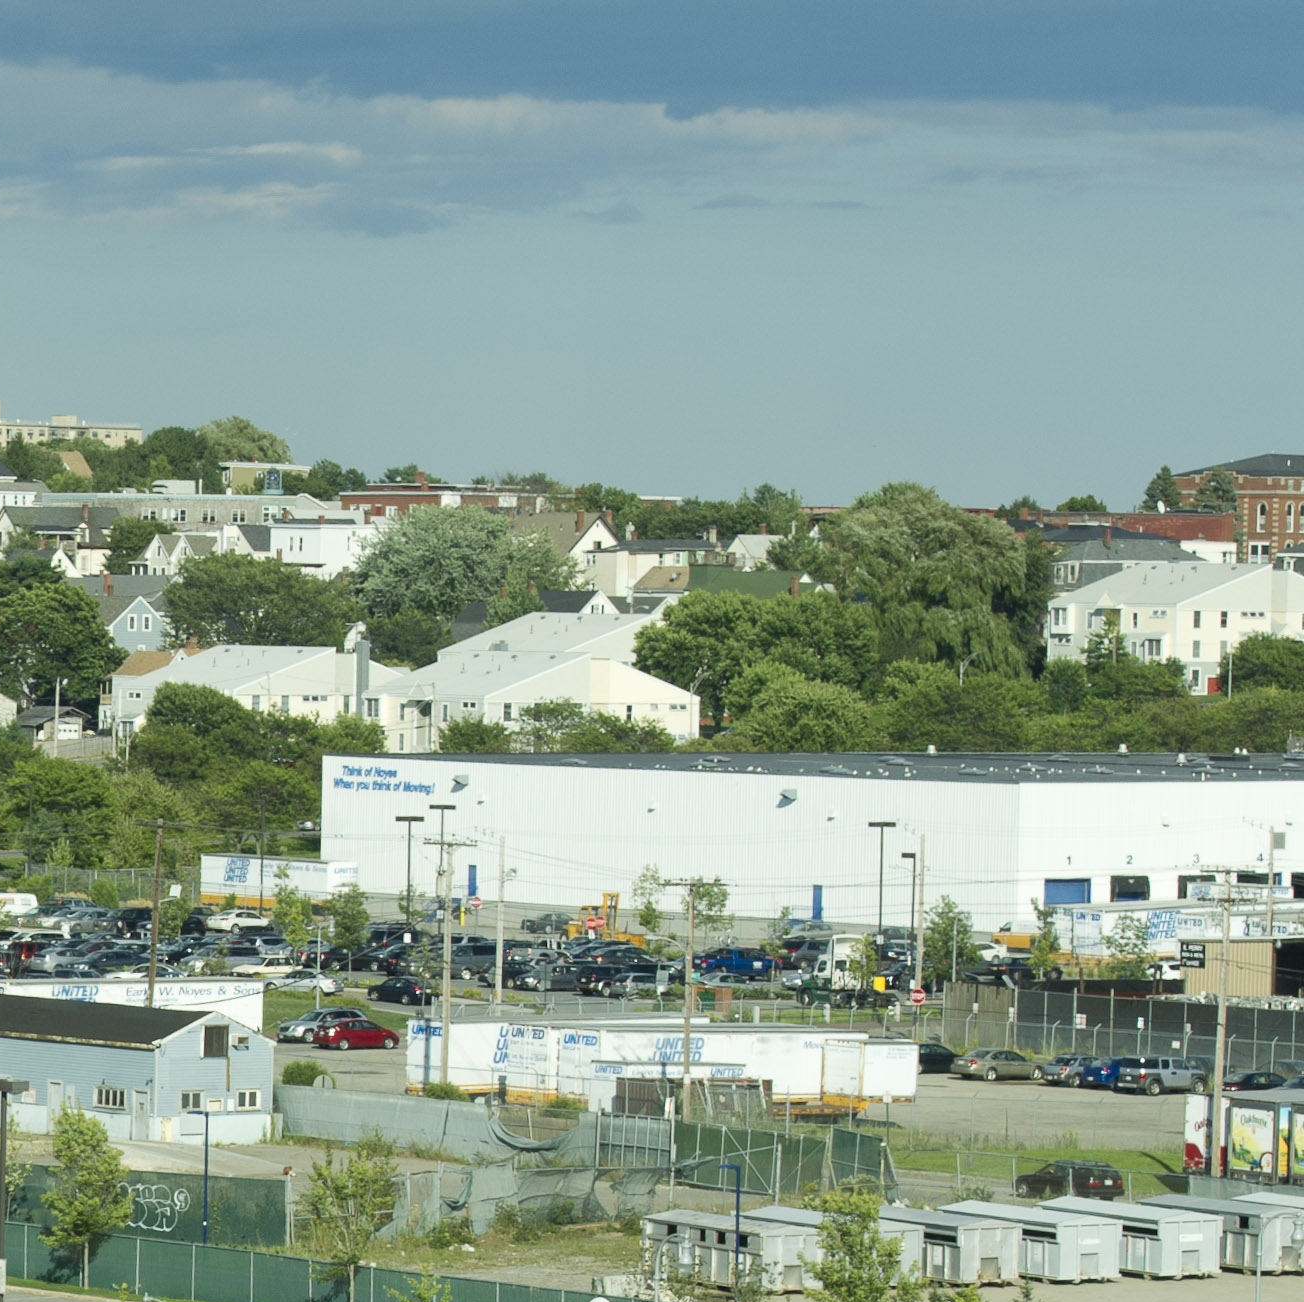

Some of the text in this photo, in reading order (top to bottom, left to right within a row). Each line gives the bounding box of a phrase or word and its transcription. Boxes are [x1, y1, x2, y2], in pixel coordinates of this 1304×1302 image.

[342, 765, 363, 777] Think
[364, 767, 374, 777] of
[333, 777, 355, 789] When
[356, 780, 371, 791] you
[372, 780, 392, 792] think
[393, 781, 403, 791] of
[227, 858, 250, 867] UNITED
[225, 867, 248, 875] UNITED
[223, 875, 247, 883] UNITED
[52, 985, 98, 996] UNITED
[179, 987, 212, 998] Noyes
[217, 986, 226, 995] &
[233, 984, 261, 995] Sons
[594, 1065, 623, 1075] UNITED
[710, 1068, 744, 1077] UNITED
